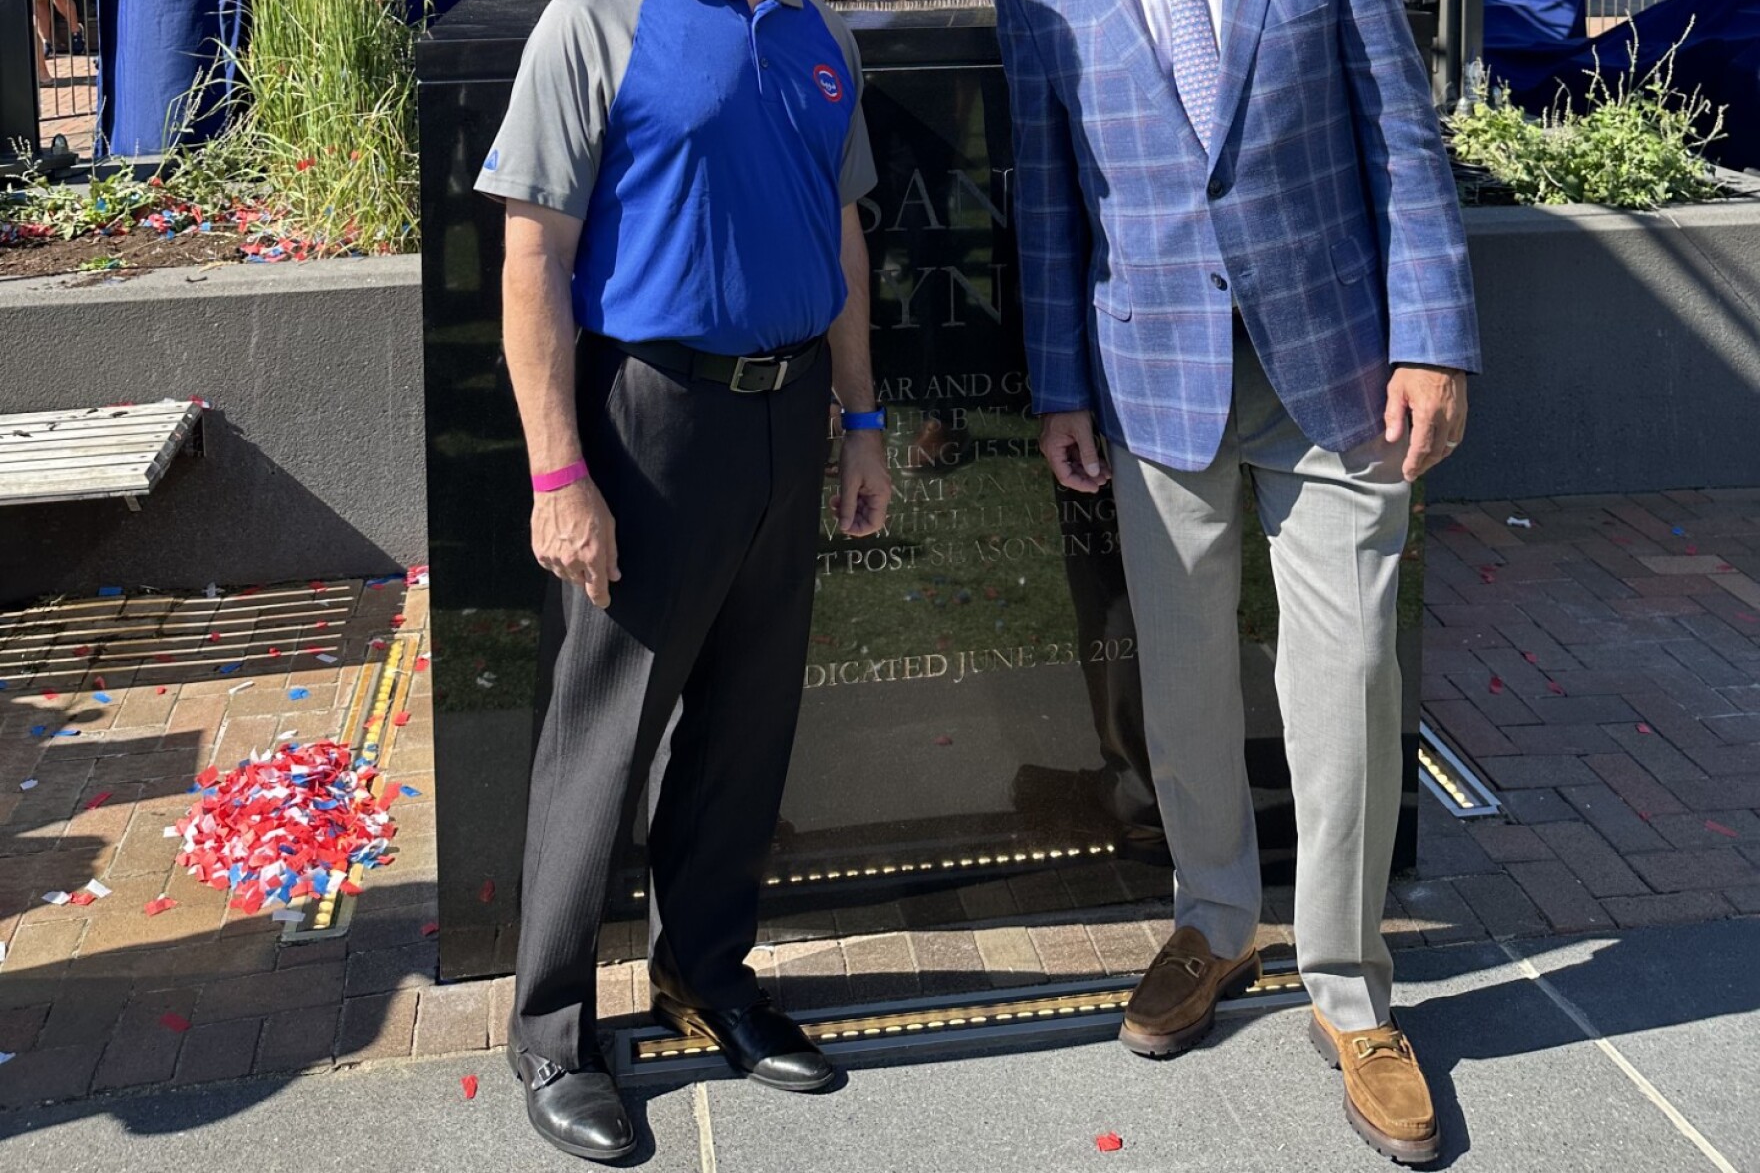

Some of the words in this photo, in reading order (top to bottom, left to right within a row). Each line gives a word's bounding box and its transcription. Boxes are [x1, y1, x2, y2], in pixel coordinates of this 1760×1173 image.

[923, 374, 992, 400] AND
[974, 439, 998, 464] 15
[844, 544, 922, 575] POST
[1060, 531, 1092, 557] IN
[952, 645, 1036, 684] JUNE
